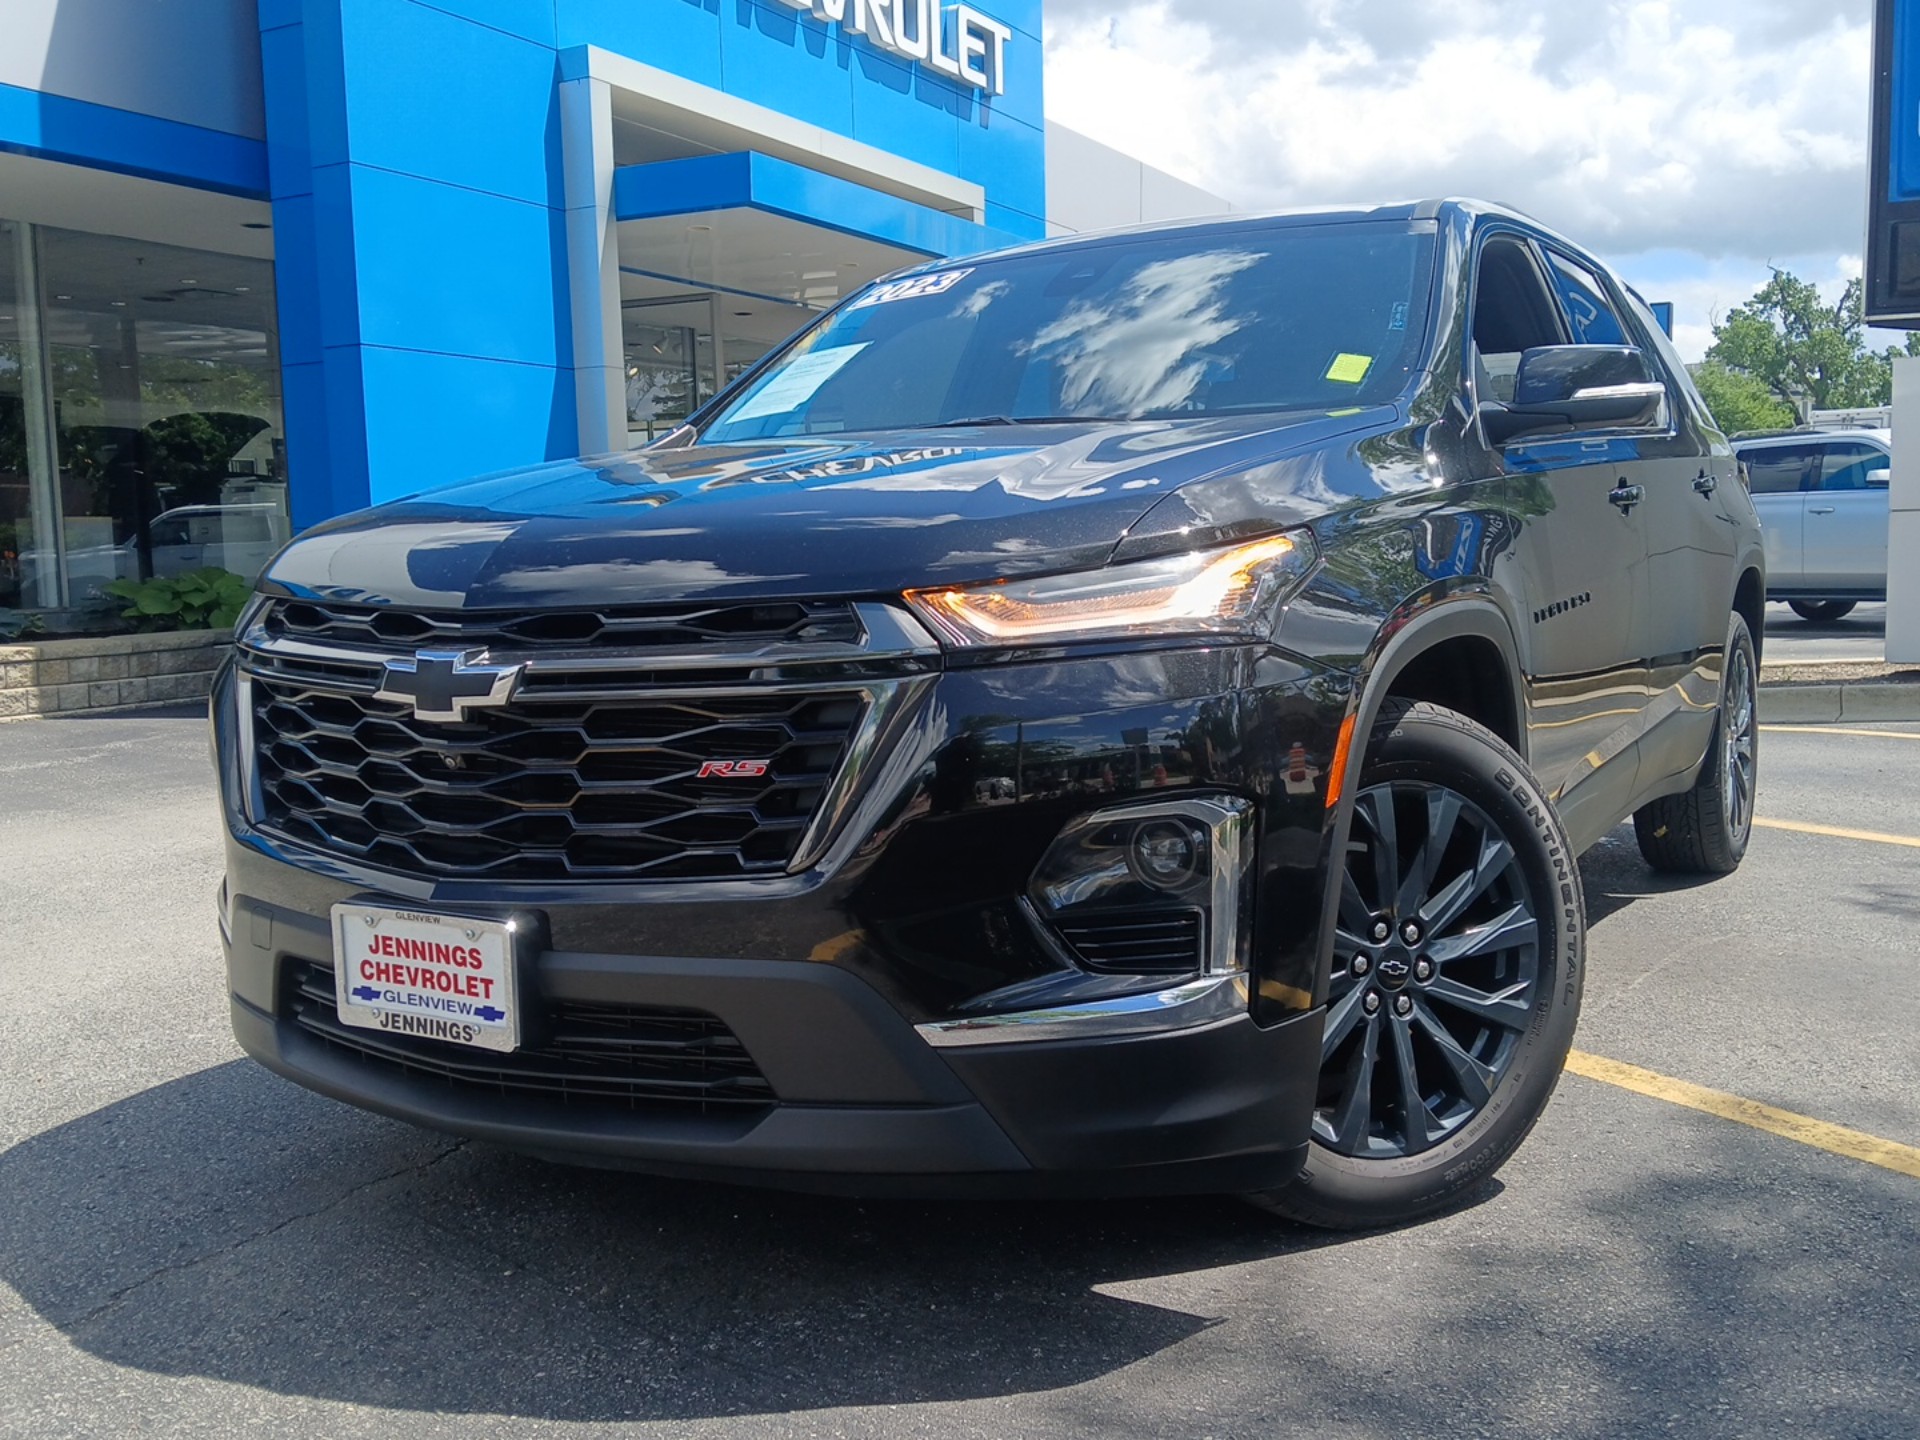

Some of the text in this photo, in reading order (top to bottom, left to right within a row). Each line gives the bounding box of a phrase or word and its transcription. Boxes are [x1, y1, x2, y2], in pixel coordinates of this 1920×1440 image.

[782, 0, 1012, 96] ROLET
[853, 270, 963, 308] 2023
[696, 759, 771, 778] RS
[1494, 768, 1578, 1006] CONTINENTAL
[395, 911, 441, 925] GLENVIEW
[368, 934, 483, 970] JENNINGS
[359, 959, 494, 1000] CHEVROLET
[383, 989, 473, 1016] GLENVIEW
[379, 1011, 474, 1043] JENNINGS
